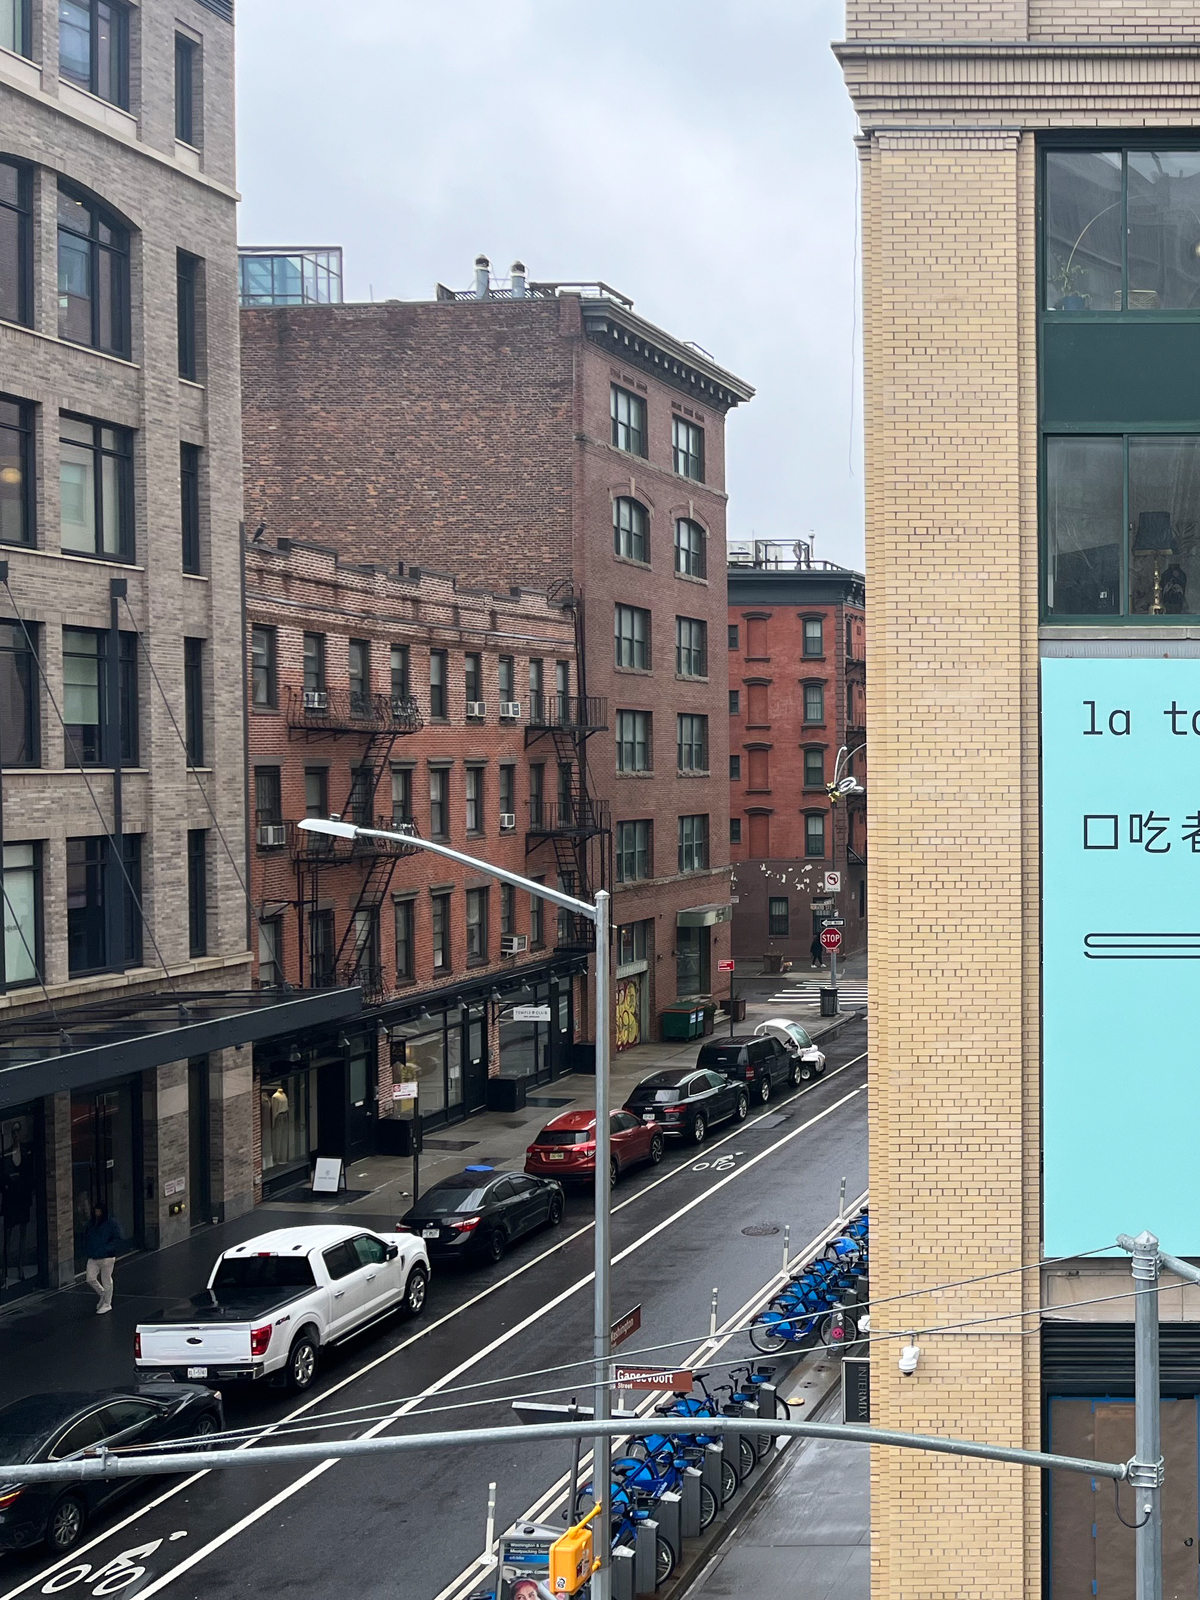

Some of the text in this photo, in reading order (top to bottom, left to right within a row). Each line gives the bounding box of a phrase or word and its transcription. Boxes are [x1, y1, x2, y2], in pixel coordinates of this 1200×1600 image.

[1082, 700, 1131, 736] la
[821, 934, 840, 943] STOP
[617, 1382, 633, 1390] Street
[858, 1366, 868, 1418] INTERMIX
